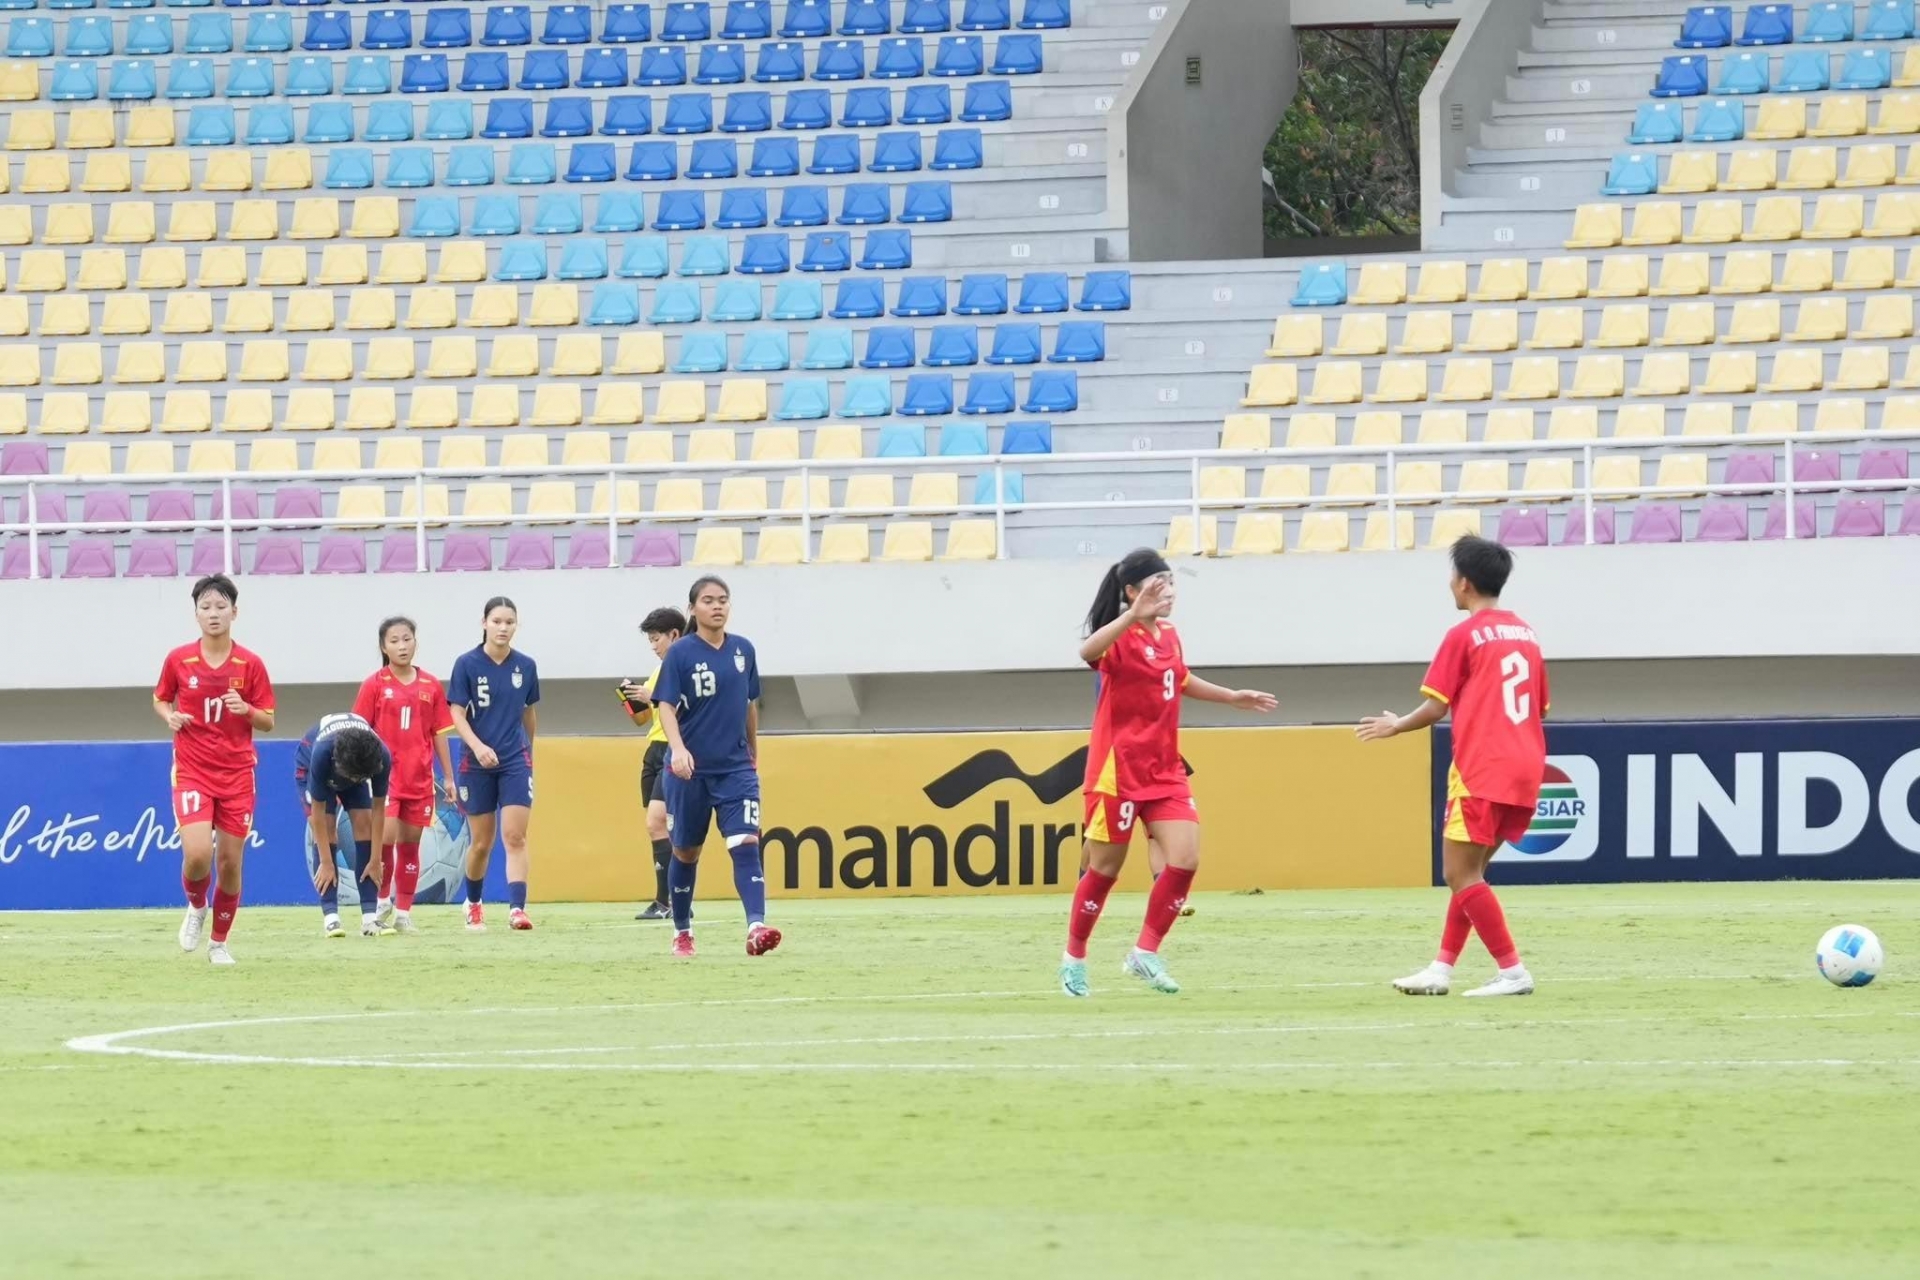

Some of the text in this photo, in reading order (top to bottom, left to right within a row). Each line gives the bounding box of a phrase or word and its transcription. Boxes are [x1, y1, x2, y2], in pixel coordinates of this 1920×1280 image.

[477, 685, 490, 708] 5
[691, 671, 716, 698] 13
[1163, 668, 1175, 701] 9
[1501, 651, 1530, 725] 2
[204, 697, 223, 724] 17
[401, 706, 412, 730] 11
[182, 790, 200, 815] 17
[743, 799, 760, 826] 13
[1118, 801, 1134, 831] 9
[1537, 800, 1586, 816] SIAR
[27, 812, 100, 859] the
[759, 800, 1086, 889] mandir
